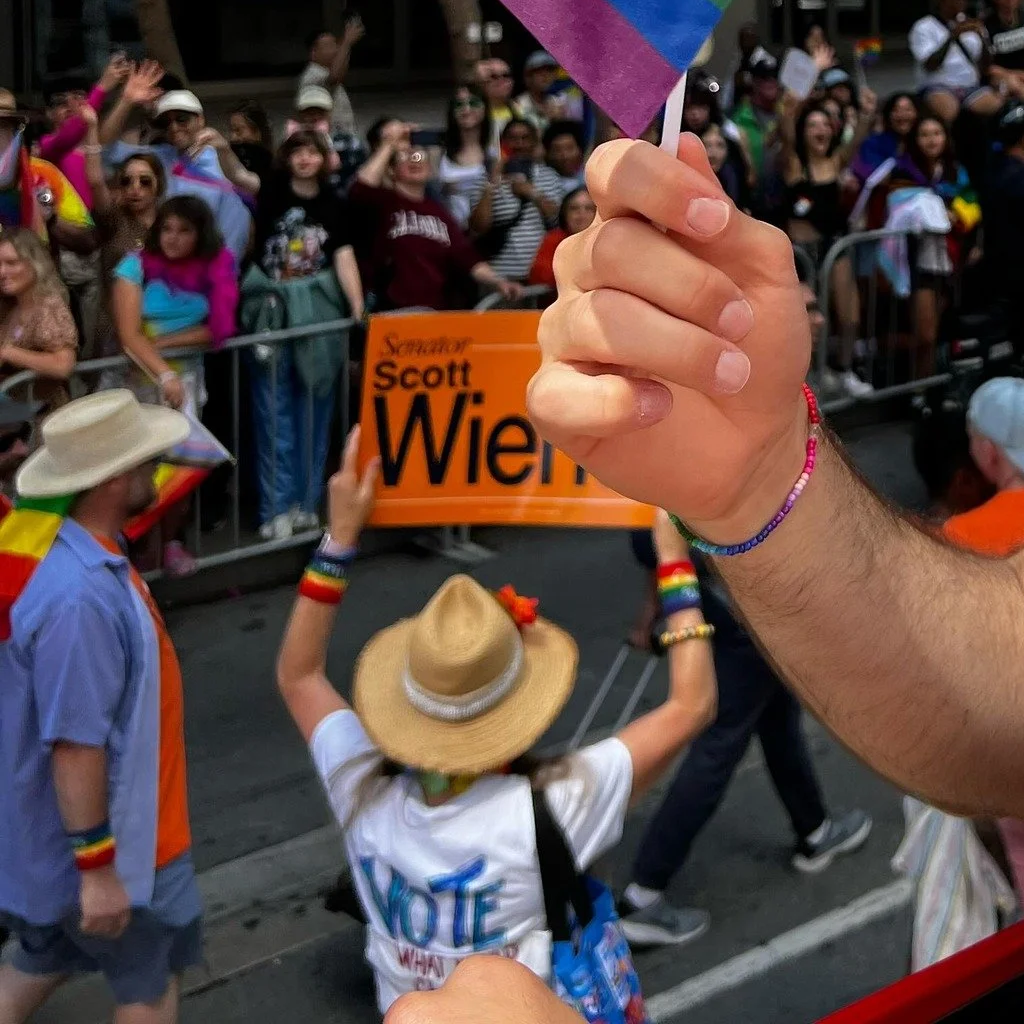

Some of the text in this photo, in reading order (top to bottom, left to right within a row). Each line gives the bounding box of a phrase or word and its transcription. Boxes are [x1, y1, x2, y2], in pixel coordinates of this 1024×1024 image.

[383, 332, 473, 356] Senator
[373, 359, 471, 391] Scott
[359, 854, 508, 950] VOTE
